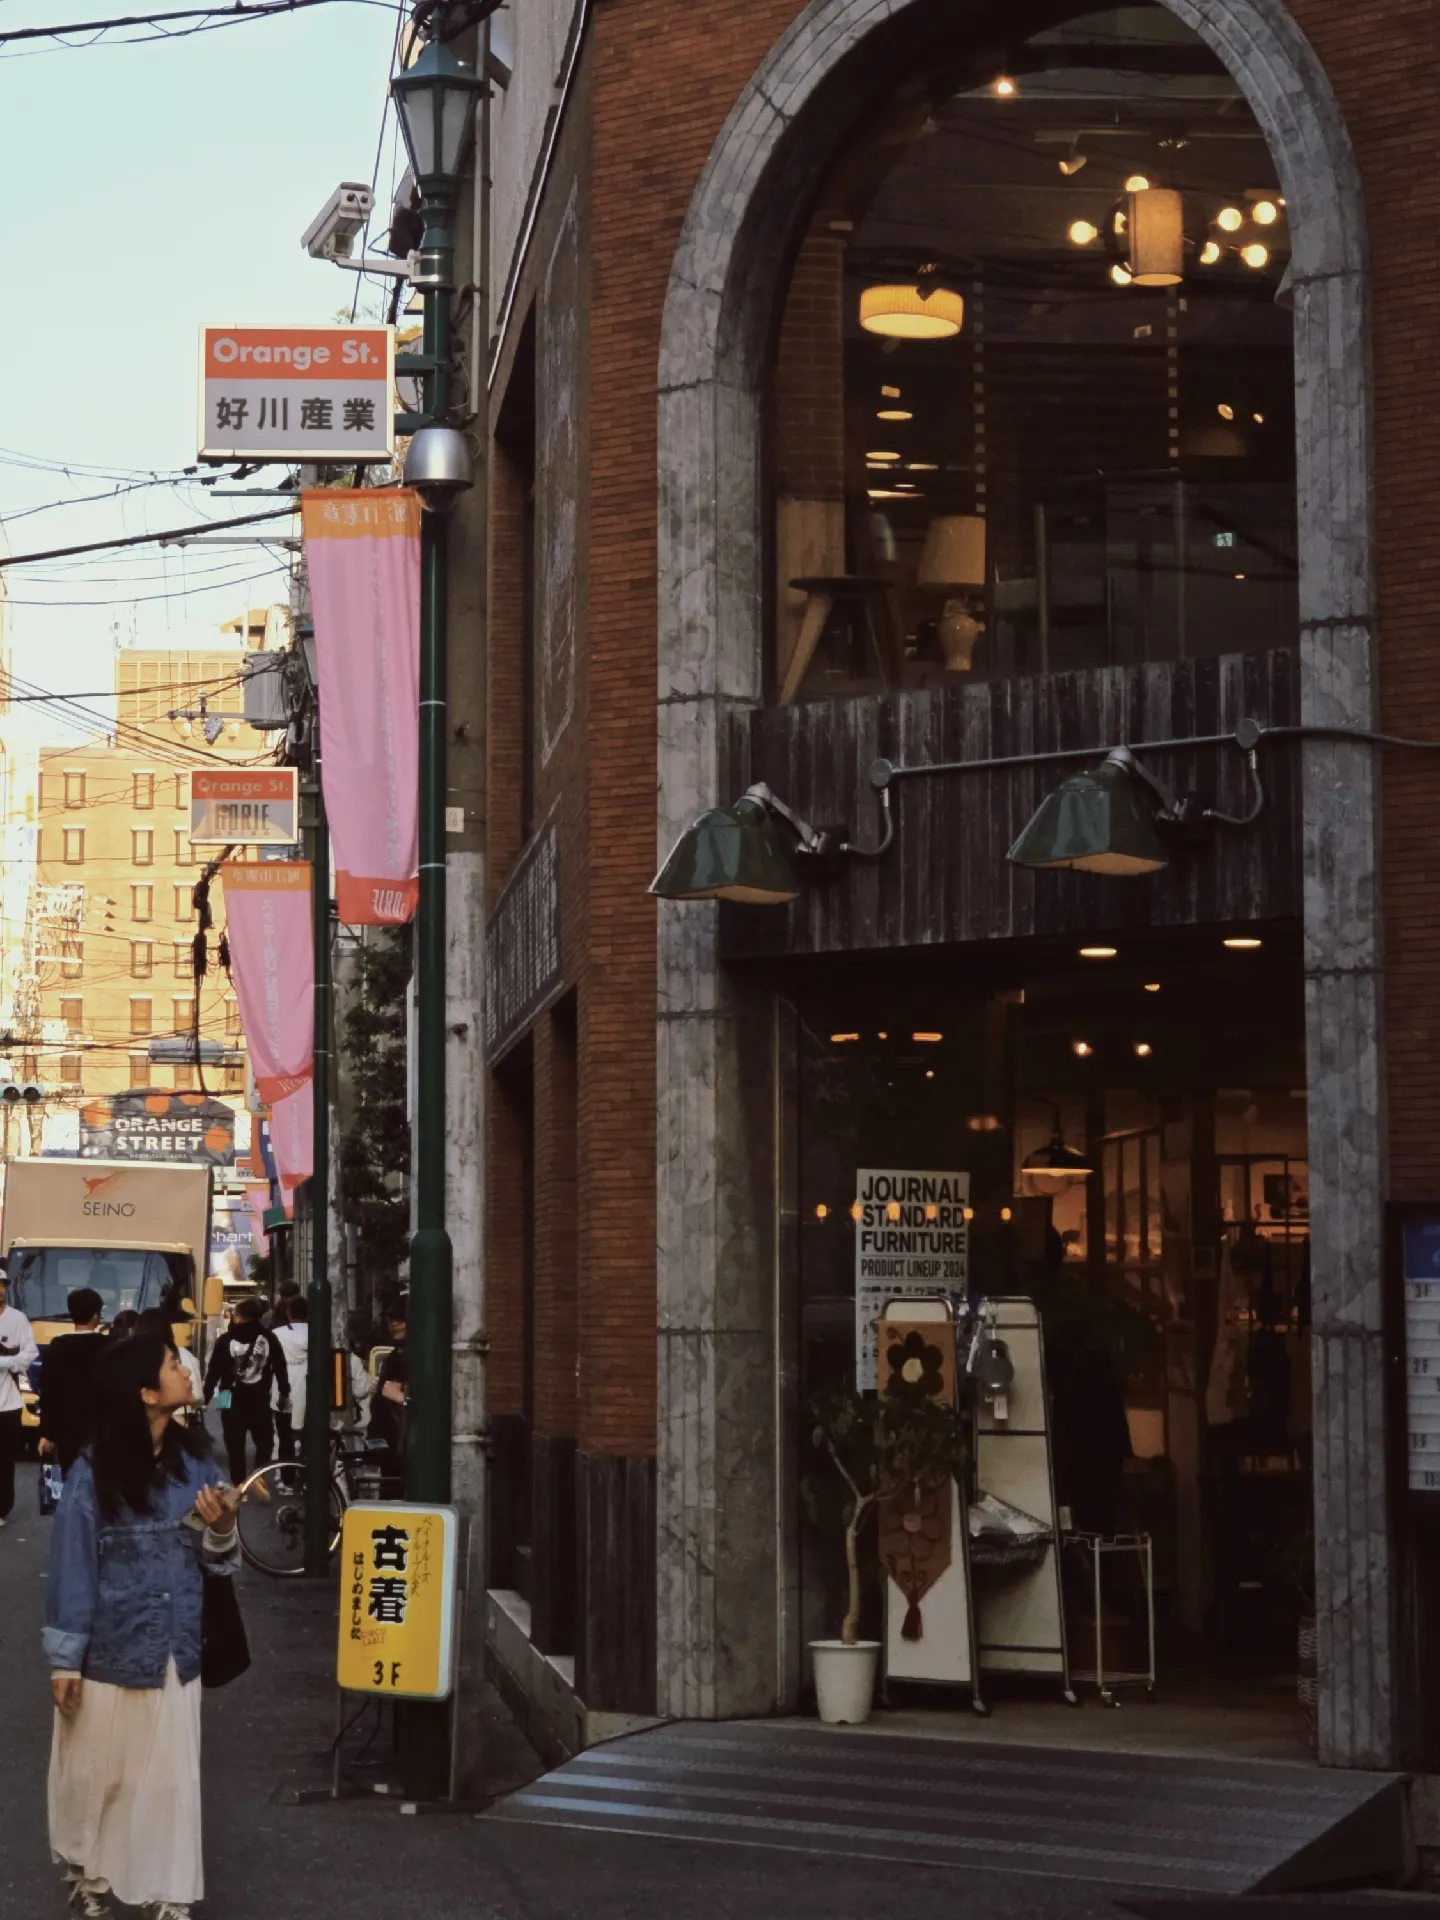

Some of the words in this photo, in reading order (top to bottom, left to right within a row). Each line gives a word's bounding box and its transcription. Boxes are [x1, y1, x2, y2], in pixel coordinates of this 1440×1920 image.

[213, 337, 331, 370] Orange
[341, 339, 379, 364] St.
[216, 396, 376, 432] 好川産業
[197, 777, 263, 796] Orange
[269, 778, 289, 792] St.
[114, 1118, 203, 1132] ORANGE
[117, 1136, 203, 1151] STREET
[861, 1175, 966, 1203] JOURNAL
[82, 1200, 136, 1217] SEINO
[861, 1231, 966, 1254] FURNITURE
[860, 1258, 906, 1277] PRODUCT
[907, 1260, 942, 1278] LINEUP
[943, 1261, 966, 1279] 2024
[368, 1525, 409, 1624] 古着
